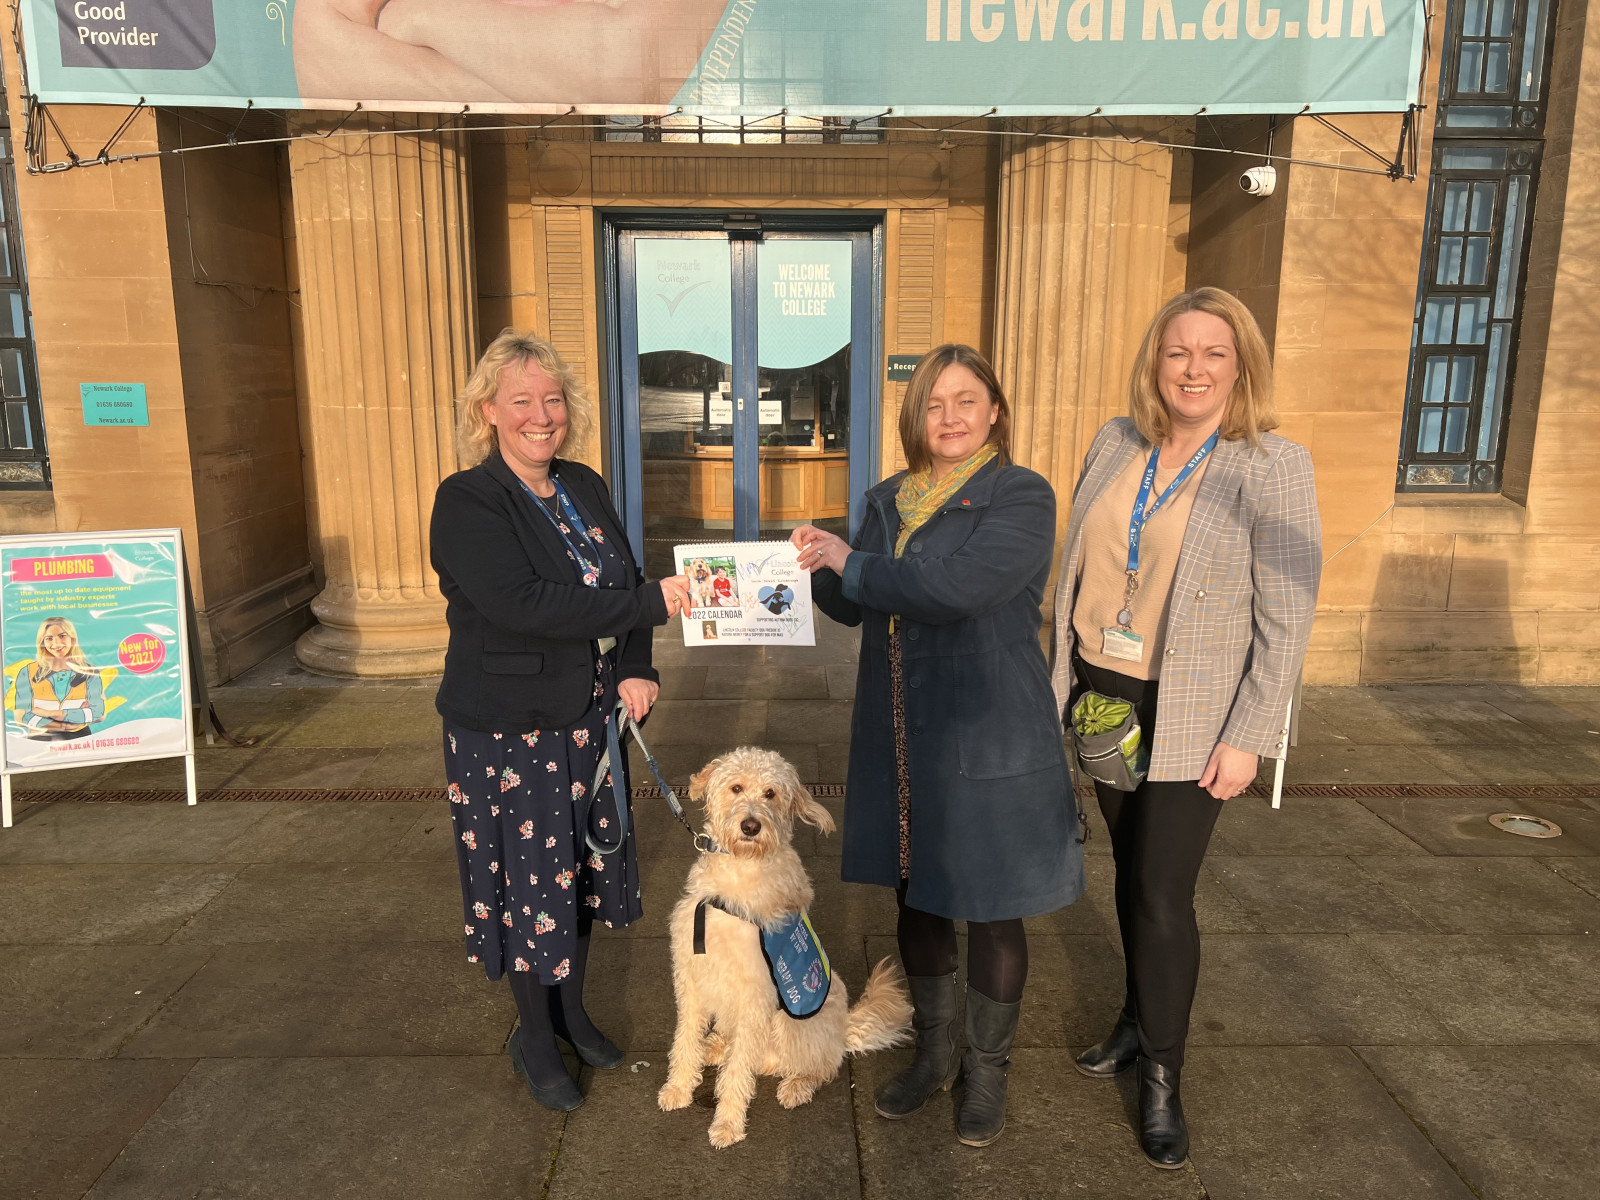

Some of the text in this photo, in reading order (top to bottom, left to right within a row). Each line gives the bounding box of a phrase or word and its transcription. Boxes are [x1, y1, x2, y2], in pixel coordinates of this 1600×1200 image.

[74, 1, 126, 20] Good
[77, 27, 159, 46] Provider
[656, 259, 701, 271] Newark
[778, 263, 830, 281] WELCOME
[657, 273, 690, 284] College
[772, 281, 836, 299] TO NEWARK
[782, 299, 827, 316] COLLEGE
[114, 385, 132, 393] College
[1188, 447, 1207, 469] STAFF
[1143, 468, 1154, 490] STAFF
[34, 559, 95, 577] PLUMBING
[92, 585, 131, 593] equipment
[20, 597, 44, 605] taught
[56, 594, 86, 602] industry
[77, 601, 118, 609] businesses
[707, 609, 743, 619] CALENDAR
[119, 637, 159, 655] New for
[129, 650, 155, 667] 2021
[776, 955, 801, 1004] THERAPY DOG
